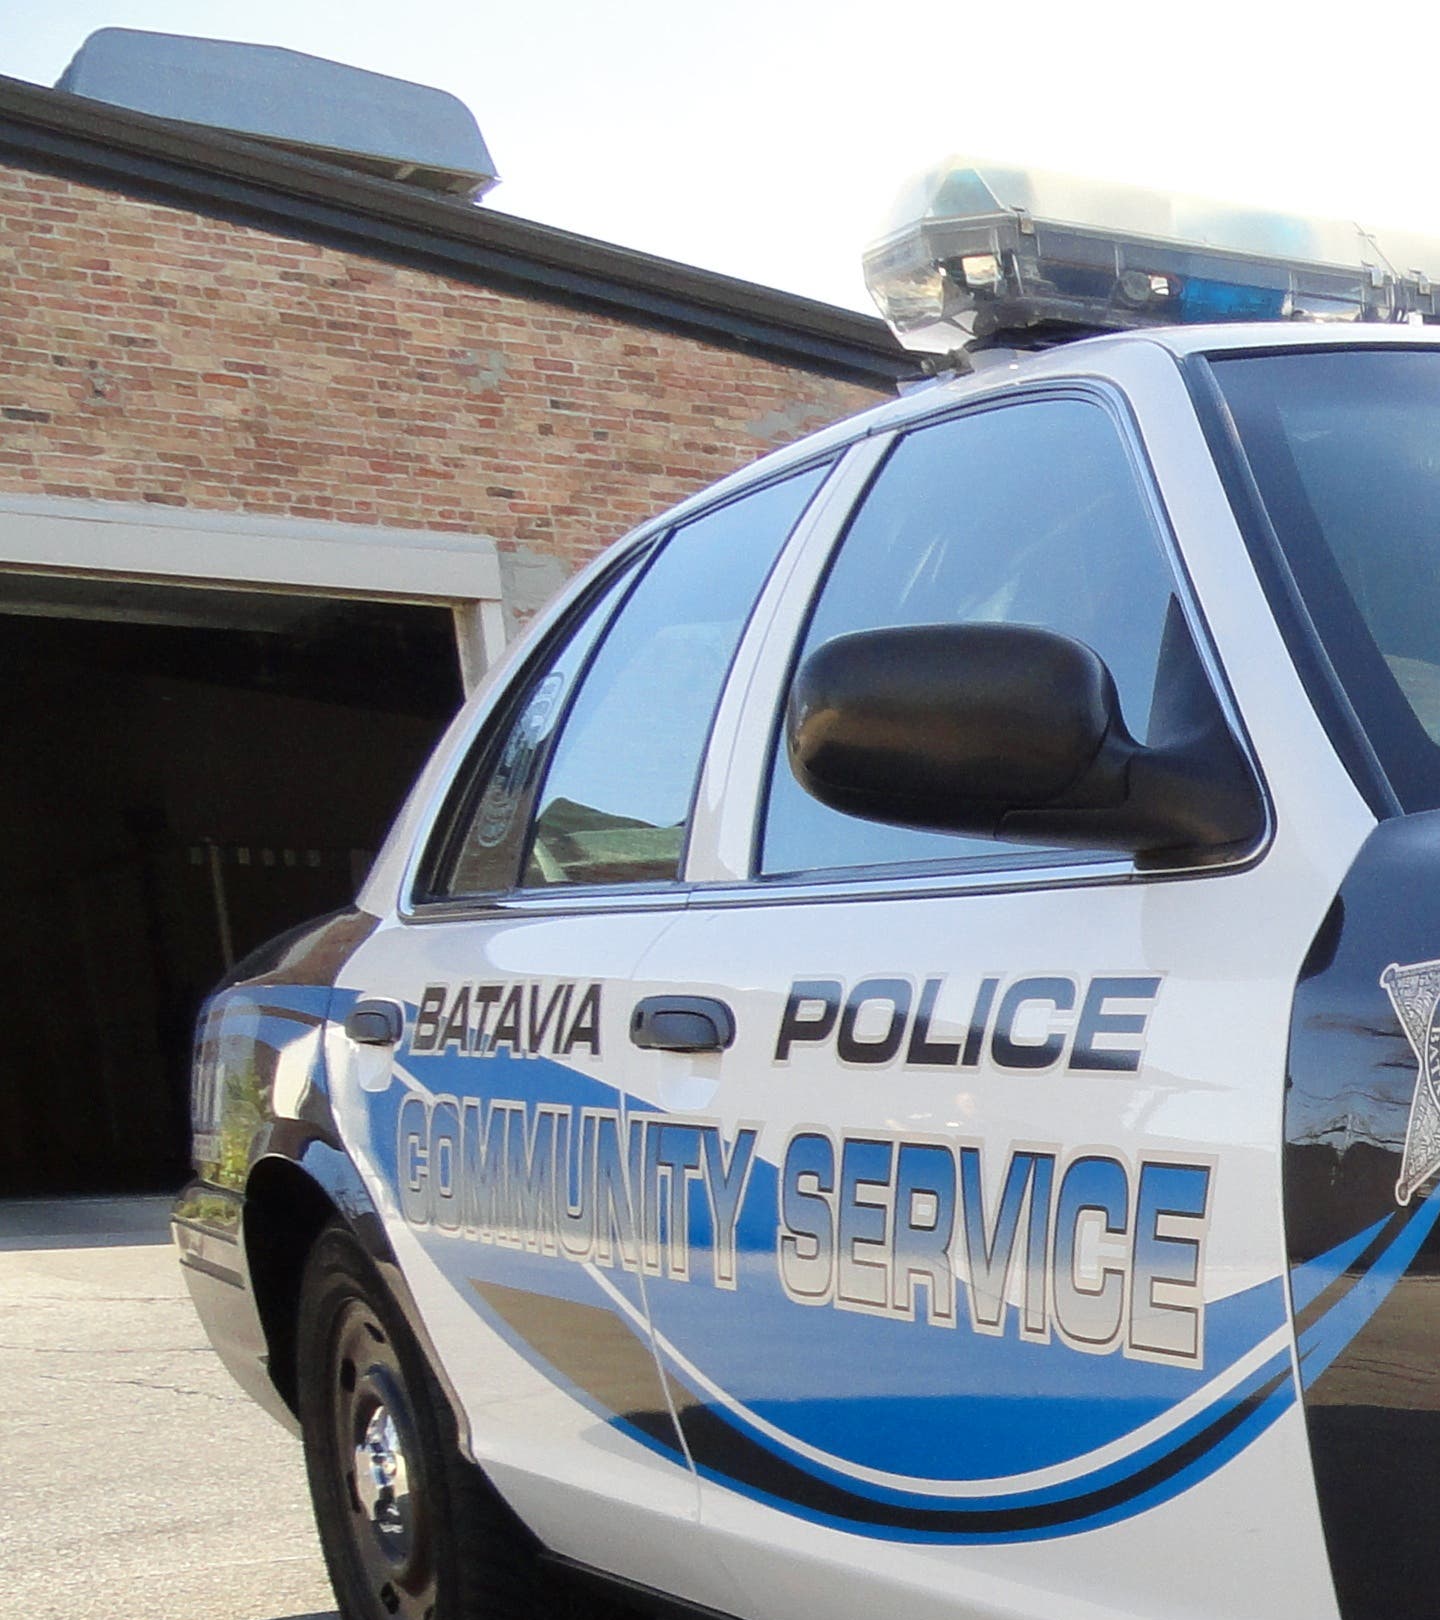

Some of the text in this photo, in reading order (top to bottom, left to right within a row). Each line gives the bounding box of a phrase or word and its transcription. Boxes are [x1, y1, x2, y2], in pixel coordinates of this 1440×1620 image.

[411, 972, 1167, 1073] BATAVIA POLICE
[400, 1093, 1217, 1369] COMMUNITY SERVICE
